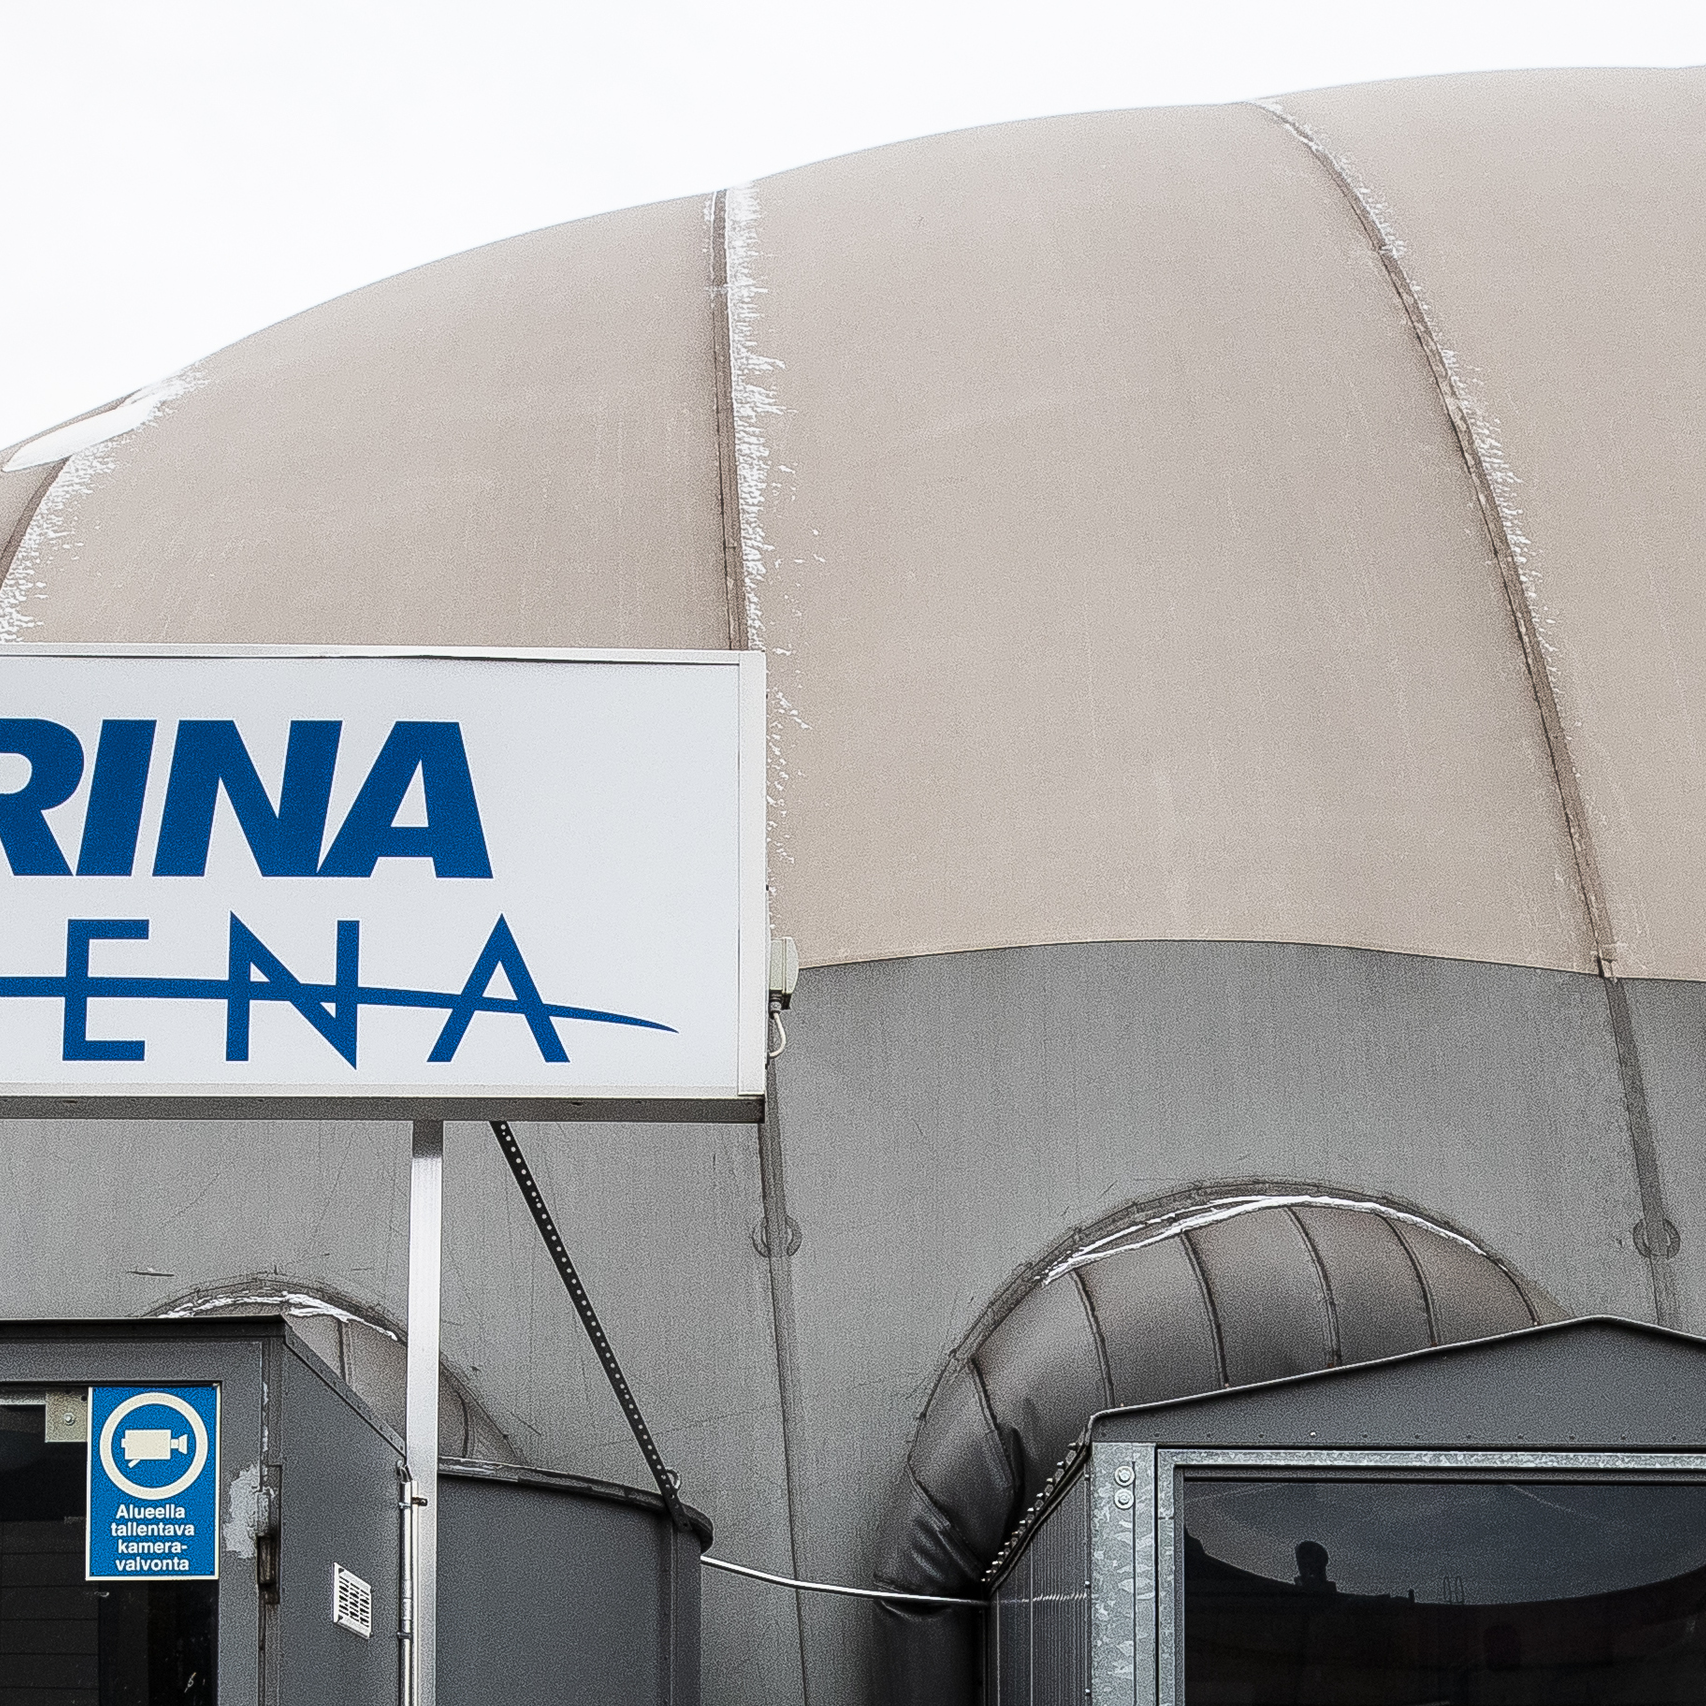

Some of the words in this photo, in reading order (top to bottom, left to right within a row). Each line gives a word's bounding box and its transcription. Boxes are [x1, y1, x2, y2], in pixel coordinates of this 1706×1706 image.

[115, 1503, 186, 1519] Alueella
[111, 1521, 195, 1536] tallentava
[118, 1539, 188, 1553] kamera-
[115, 1556, 190, 1571] valvonta
